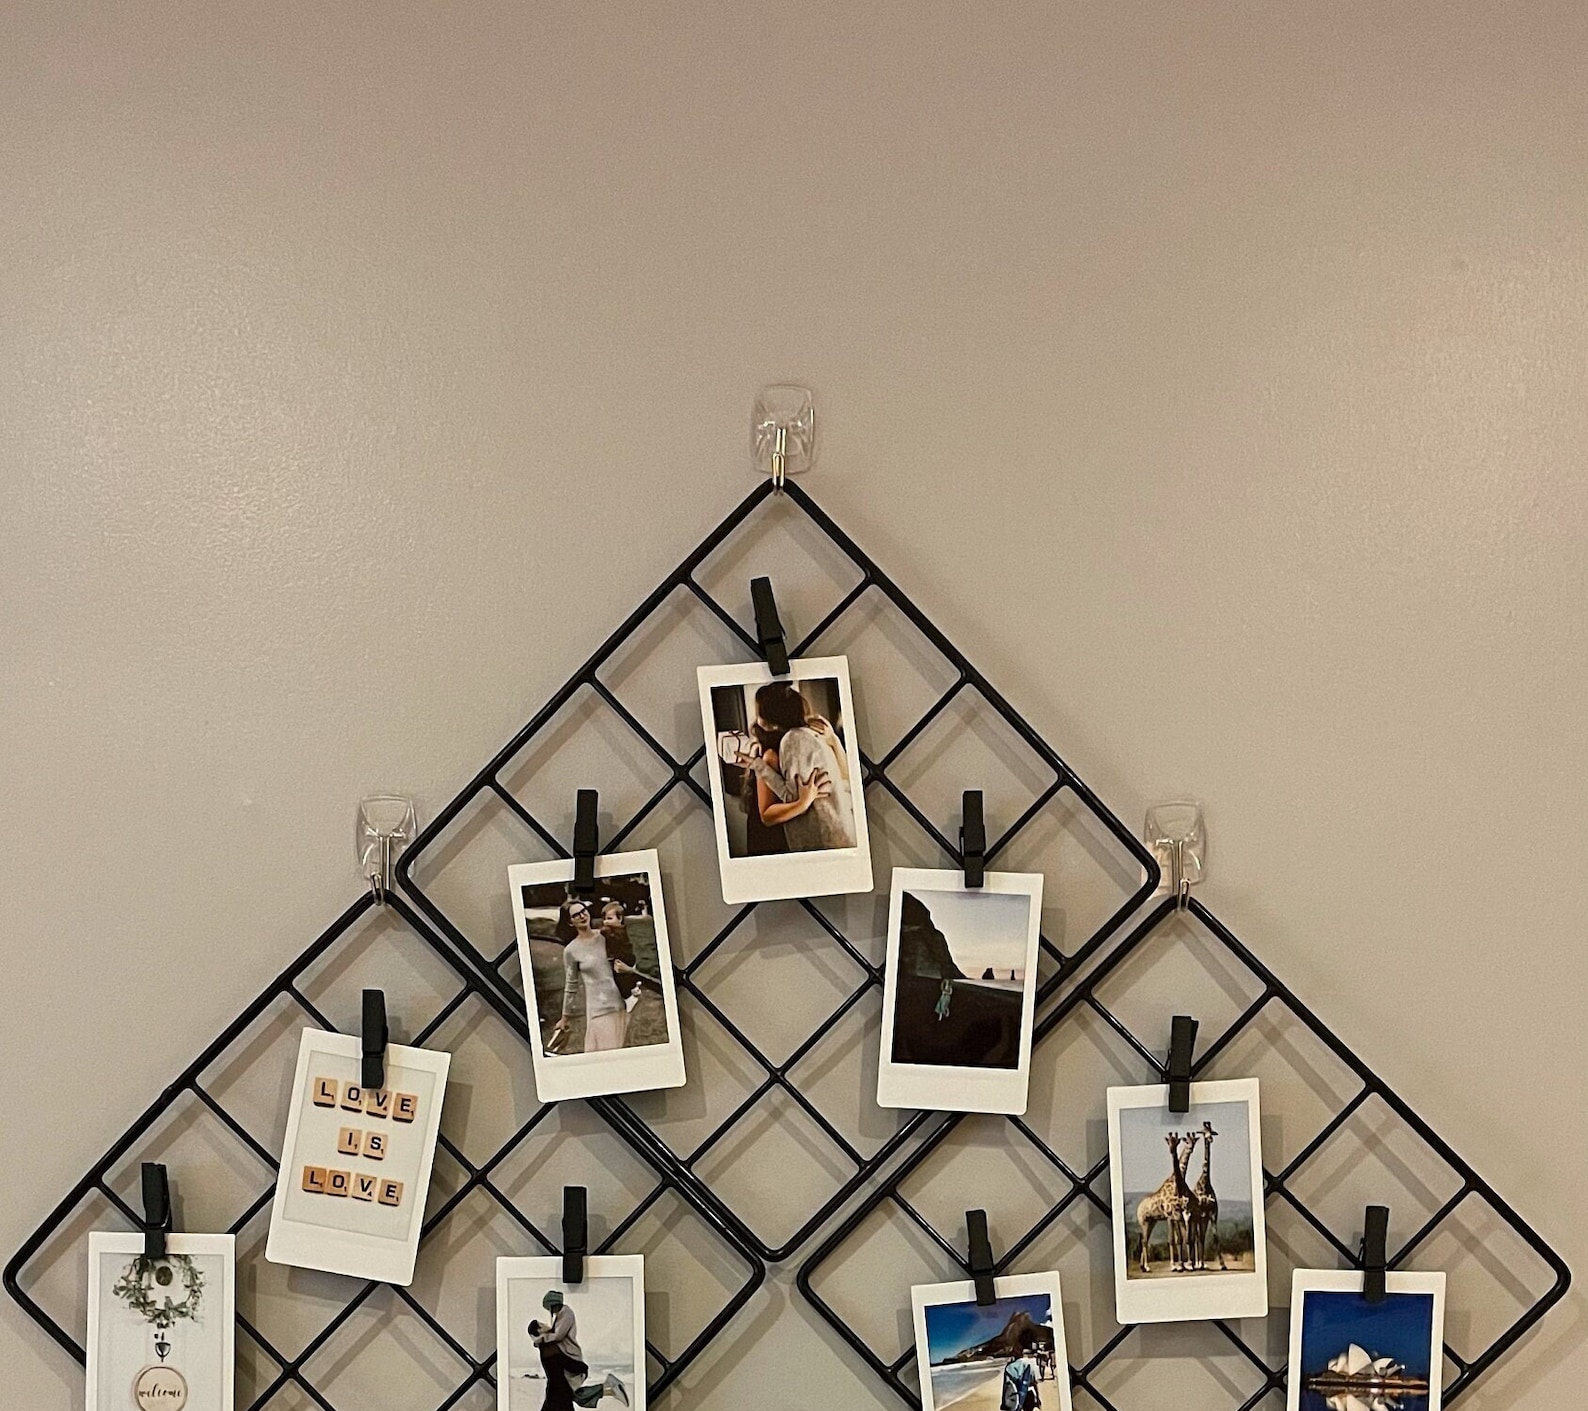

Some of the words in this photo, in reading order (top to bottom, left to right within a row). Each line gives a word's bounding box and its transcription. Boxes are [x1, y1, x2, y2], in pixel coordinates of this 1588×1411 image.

[320, 1081, 415, 1116] LOVE
[346, 1132, 384, 1154] IS
[309, 1170, 399, 1202] LOVE
